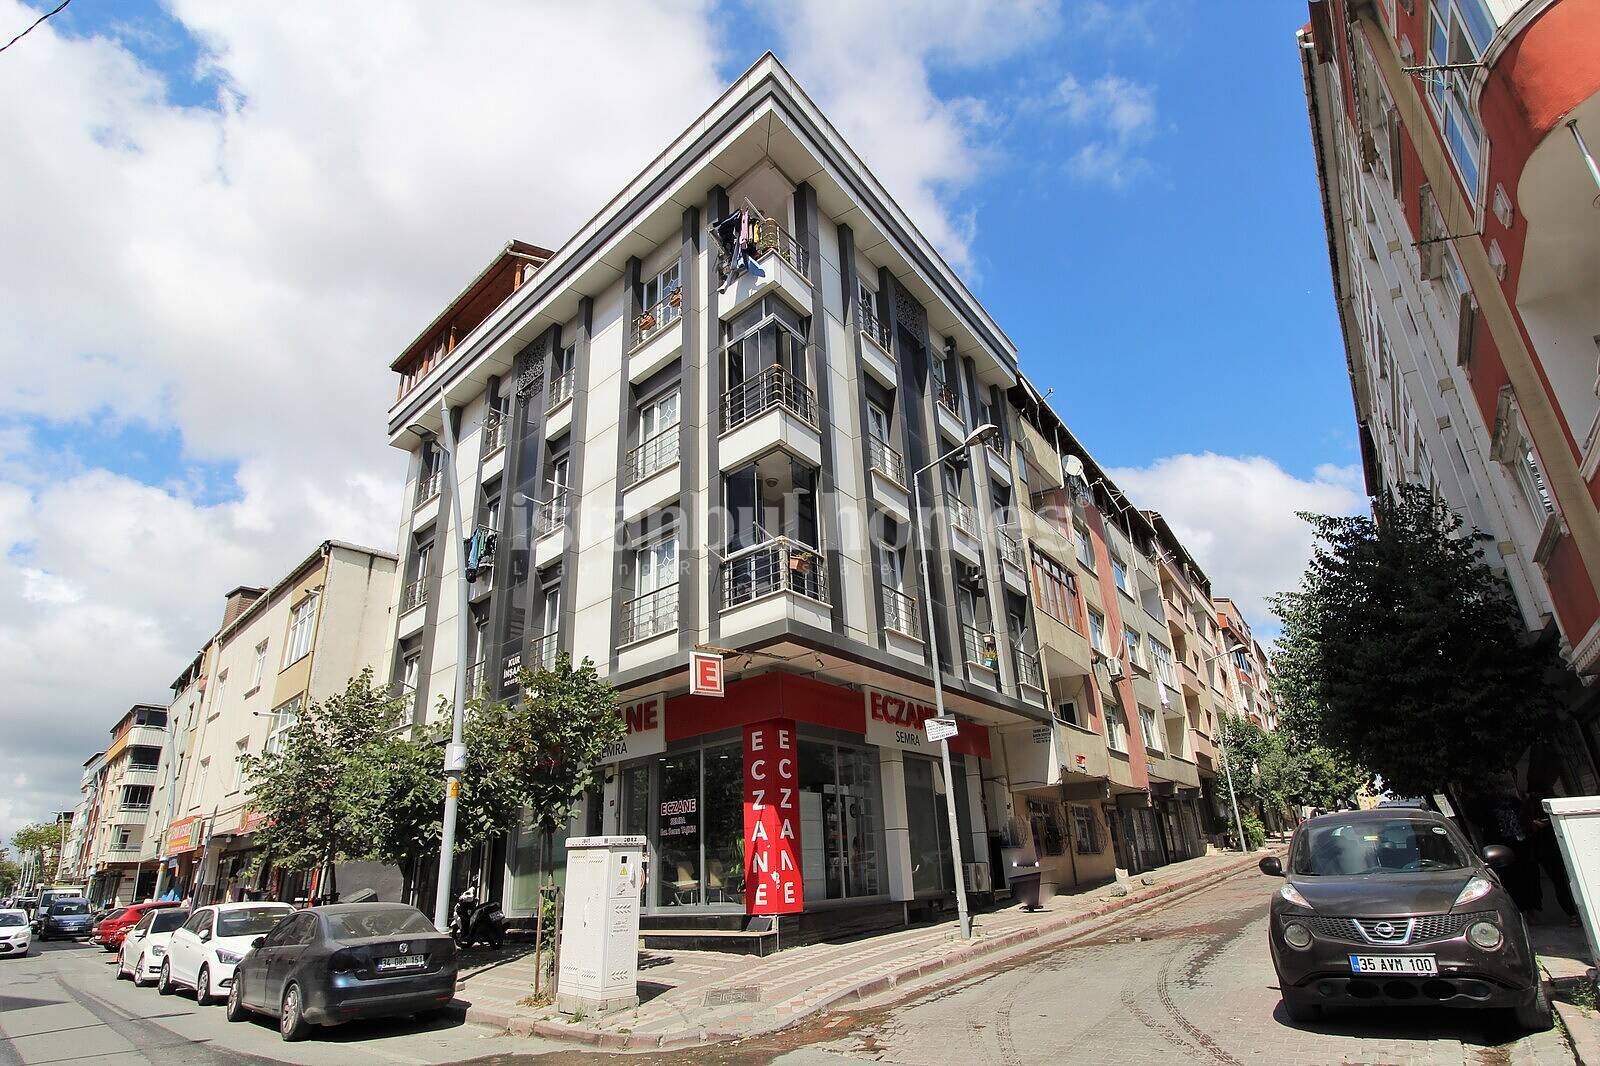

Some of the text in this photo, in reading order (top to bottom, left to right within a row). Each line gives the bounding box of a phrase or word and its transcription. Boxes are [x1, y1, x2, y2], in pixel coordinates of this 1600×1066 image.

[700, 660, 718, 688] E
[896, 730, 921, 747] SEMRA
[660, 798, 697, 816] ECZANE
[751, 730, 769, 906] ECZANE
[1359, 958, 1376, 971] 35
[1380, 958, 1404, 972] AVM
[1409, 958, 1432, 972] 100
